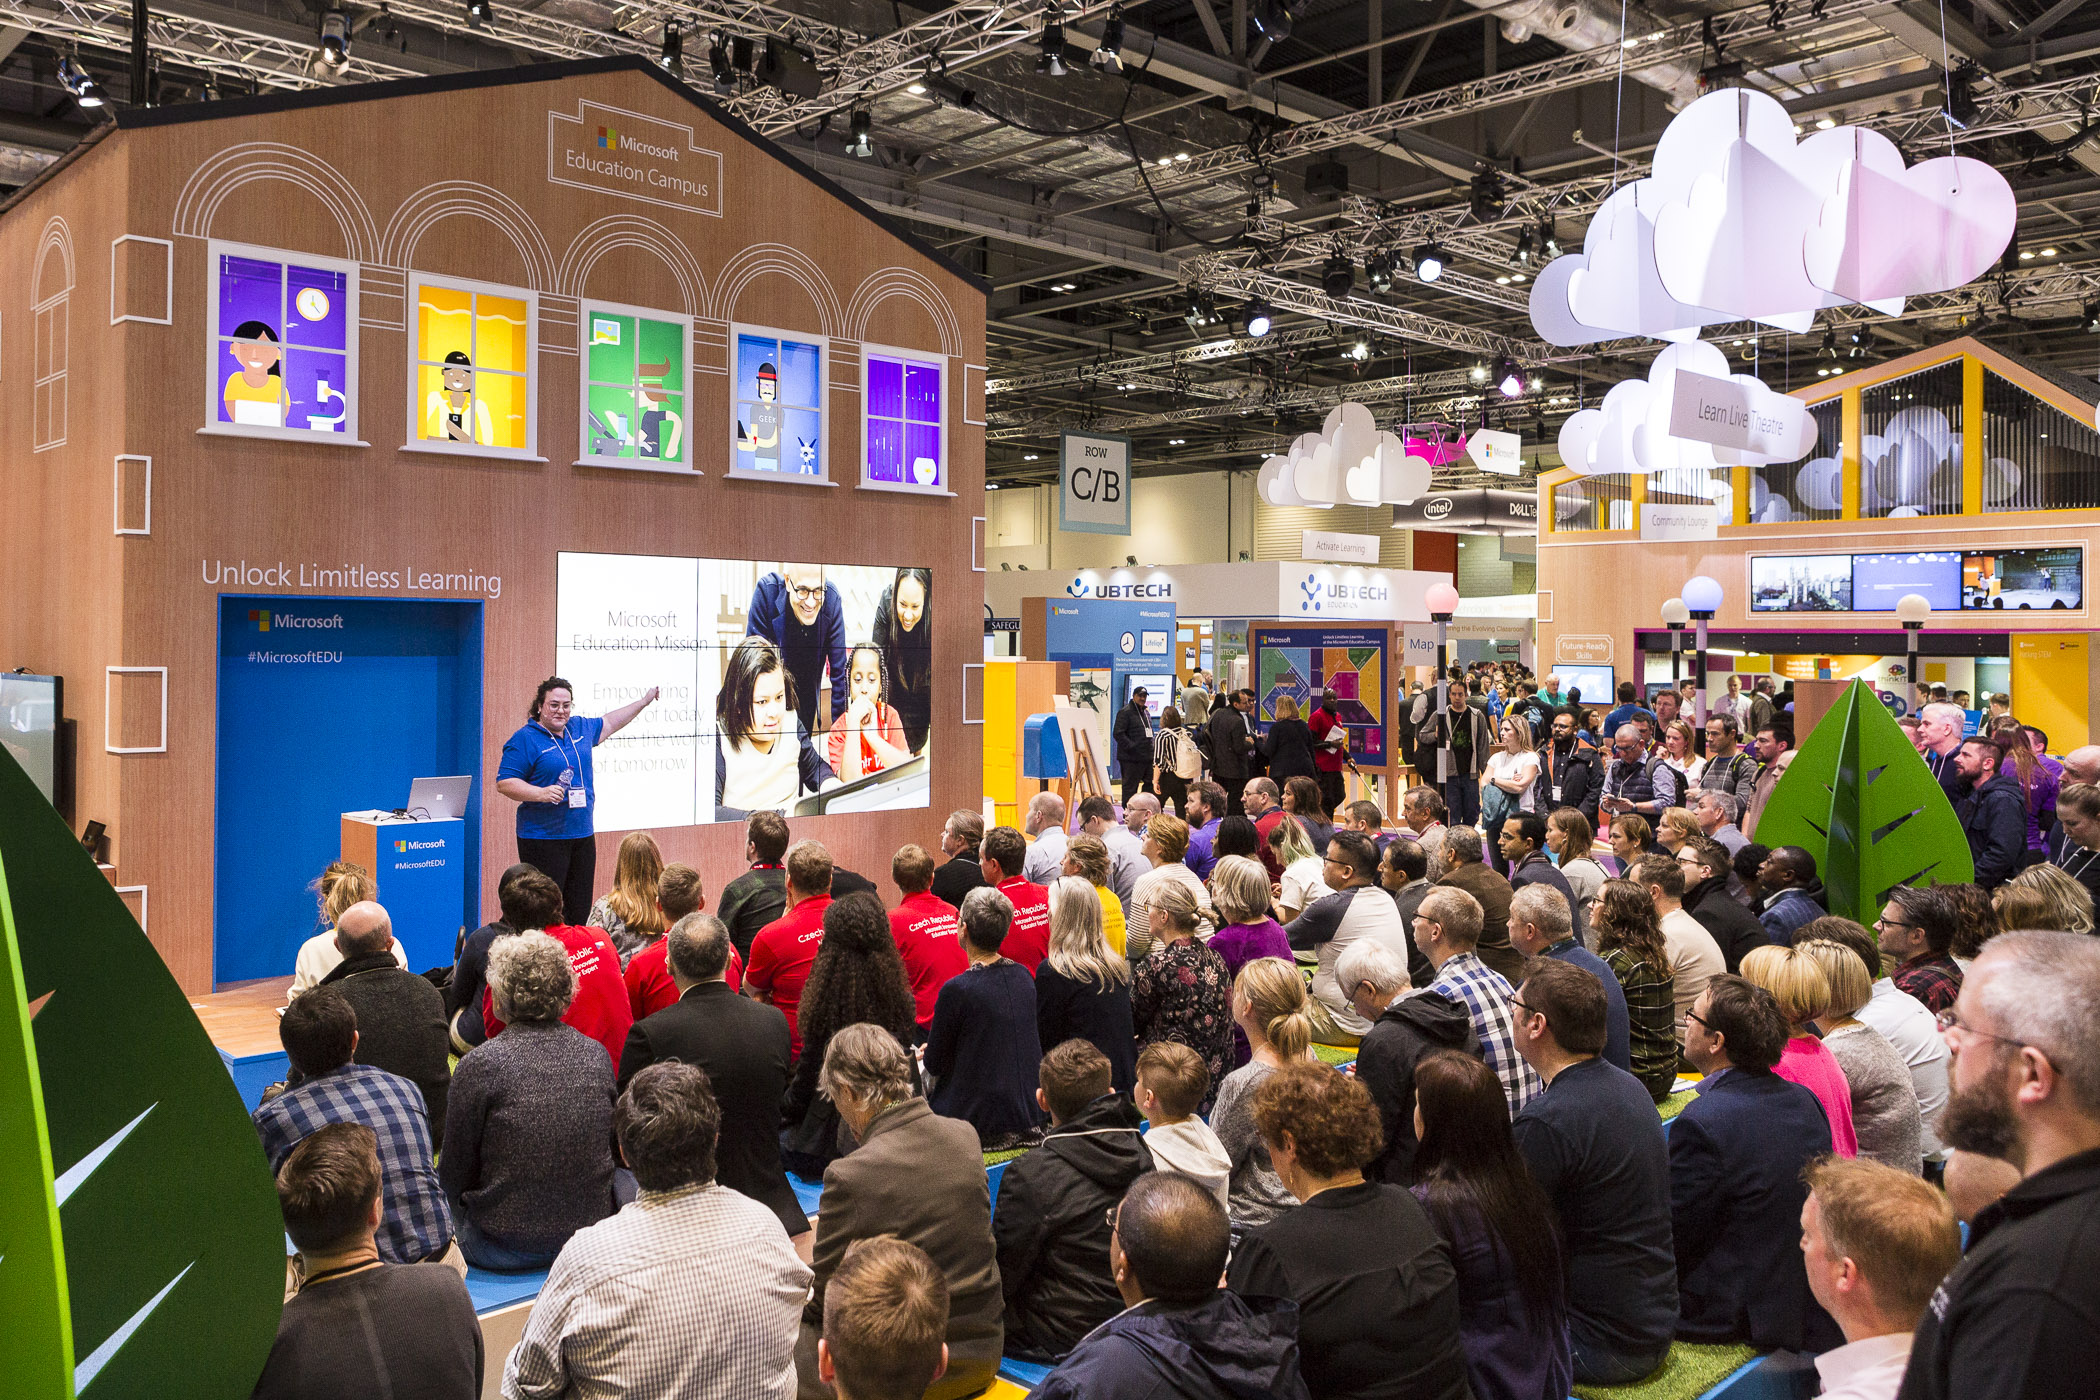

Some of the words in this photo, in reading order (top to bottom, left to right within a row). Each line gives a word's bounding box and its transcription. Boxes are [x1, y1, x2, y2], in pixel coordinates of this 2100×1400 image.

[620, 135, 679, 162] Microsoft
[566, 149, 644, 183] Education
[648, 168, 709, 197] Campus
[758, 415, 776, 424] GEEK
[1698, 398, 1727, 425] Learn
[1729, 405, 1748, 428] Live
[1751, 410, 1784, 436] Theatre
[1084, 446, 1108, 458] ROW
[1071, 466, 1120, 502] C/B
[1427, 502, 1448, 514] intel
[1652, 514, 1686, 529] Community
[1687, 515, 1708, 530] Lounge
[1316, 540, 1340, 551] Activate
[1340, 543, 1366, 556] Learning
[202, 560, 292, 587] Unlock
[300, 563, 400, 589] Limitless
[407, 566, 501, 599] Learning
[1096, 584, 1172, 598] UBTECH
[1328, 584, 1388, 600] UBTECH
[274, 614, 344, 629] Microsoft
[608, 610, 678, 628] Microsoft
[573, 634, 649, 651] Education
[654, 636, 708, 652] Mission
[1410, 638, 1434, 652] Map
[1562, 642, 1607, 651] Future-Ready
[248, 650, 343, 664] #MicrosoftEDU
[1576, 652, 1592, 660] Skills
[593, 682, 688, 704] Empowring
[644, 706, 659, 723] of
[664, 704, 705, 726] today
[642, 729, 665, 748] the
[670, 728, 710, 746] world
[593, 756, 608, 774] of
[614, 757, 688, 773] tomorrow
[408, 838, 446, 850] Microsoft
[394, 859, 446, 870] #MicrosoftEDU
[1021, 903, 1047, 915] Republic
[909, 918, 930, 932] Czech
[930, 914, 955, 924] Republic
[798, 928, 825, 943] Czech
